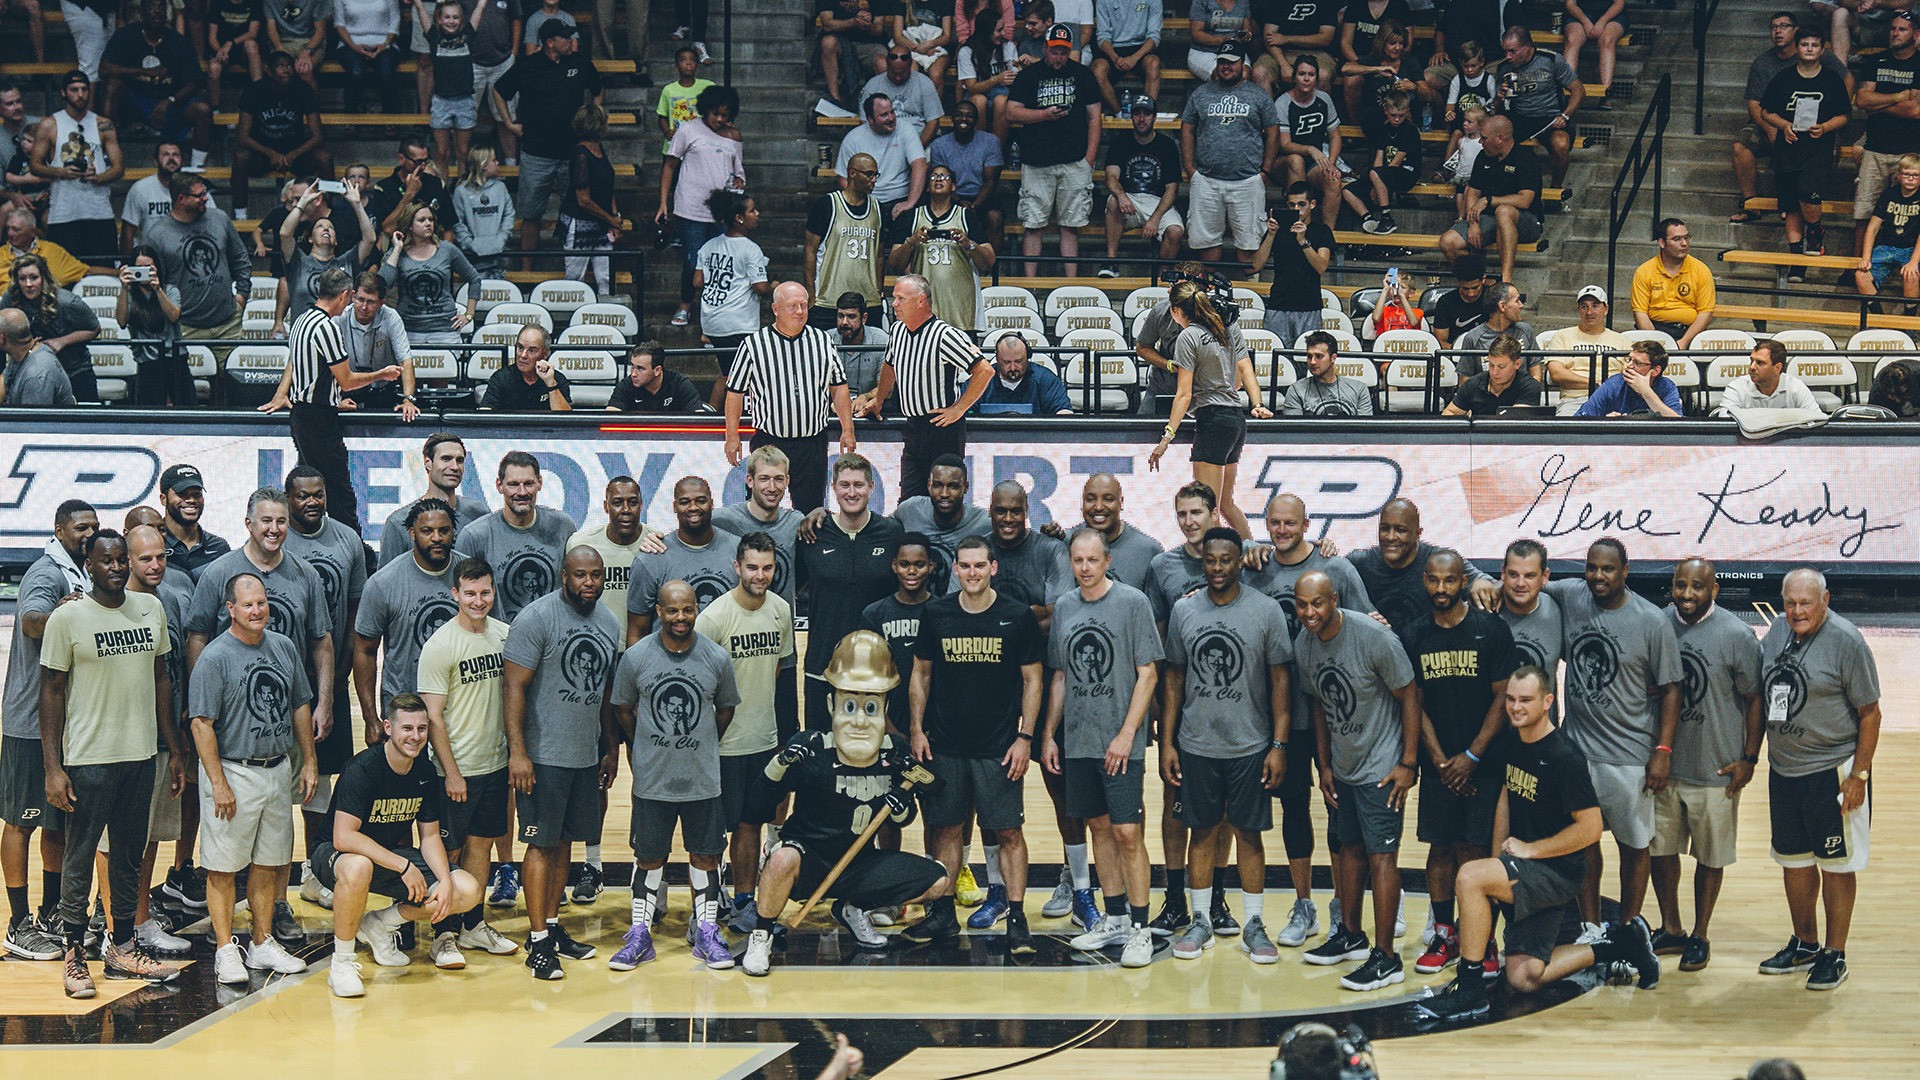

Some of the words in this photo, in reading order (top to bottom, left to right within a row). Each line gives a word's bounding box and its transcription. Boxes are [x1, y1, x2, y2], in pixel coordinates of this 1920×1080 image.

[1288, 4, 1316, 20] P
[1357, 21, 1379, 32] PURD
[1221, 96, 1236, 105] GO
[1208, 103, 1249, 116] BOILERS
[1221, 115, 1236, 125] P
[1296, 112, 1324, 136] P
[148, 202, 171, 215] PUR
[472, 206, 498, 215] PURDUE
[1887, 201, 1920, 216] BOILER
[1894, 214, 1909, 226] UP
[841, 226, 876, 240] PURDUE
[847, 239, 868, 259] 31
[928, 244, 951, 265] 31
[704, 268, 734, 290] JAG
[82, 285, 120, 297] PURDU
[481, 289, 511, 301] RDUE
[542, 290, 585, 302] PURDUE
[983, 296, 1027, 307] PURDUE
[1056, 297, 1099, 308] PURDUE
[497, 314, 541, 324] PURDUE
[582, 313, 626, 326] PURDUE
[987, 316, 1031, 328] PURDUE
[1067, 317, 1111, 329] PURDUE
[483, 334, 518, 345] PURDU
[569, 335, 613, 345] PURDUE
[1071, 338, 1115, 350] PURDUE
[1245, 339, 1272, 351] RDUE
[1384, 340, 1428, 352] PURDUE
[1701, 340, 1747, 350] PURDUE
[1782, 340, 1825, 350] URDUE
[1860, 340, 1905, 350] PURDUE
[93, 354, 124, 366] RDUE
[238, 354, 286, 367] PURDUE
[412, 355, 444, 368] RDUE
[558, 357, 604, 370] PURDUE
[1078, 361, 1124, 373] PUDUE
[1334, 364, 1363, 376] RDUE
[1721, 365, 1750, 377] PURD
[1798, 363, 1843, 376] PURDUE
[664, 397, 672, 407] P
[0, 444, 160, 535] P
[1243, 456, 1402, 545] P
[1518, 454, 1680, 538] Gene
[1697, 464, 1902, 558] Keady
[604, 566, 630, 582] URD
[603, 582, 629, 591] ASKET
[882, 619, 920, 641] PURD
[94, 627, 153, 649] PURDUE
[730, 631, 781, 651] PURDUE
[97, 643, 154, 658] BASKETBALL
[941, 637, 1003, 655] PURDUE
[731, 648, 781, 659] BASKETBALL
[945, 653, 1001, 663] BASKETBALL
[459, 652, 503, 677] PURDU
[1420, 651, 1478, 671] PURDUE
[461, 670, 503, 685] BASKETBA
[1424, 667, 1477, 680] BASKETBALL
[558, 690, 581, 703] The
[1072, 685, 1088, 698] The
[1194, 685, 1212, 698] The
[250, 727, 273, 740] The
[650, 734, 671, 748] The
[901, 764, 935, 784] P
[836, 775, 892, 802] PURDUE
[371, 797, 423, 816] PURDUE
[22, 808, 41, 819] P
[368, 813, 416, 823] BASKETBALL
[851, 804, 873, 835] 0
[525, 826, 538, 837] P
[1824, 836, 1842, 848] P
